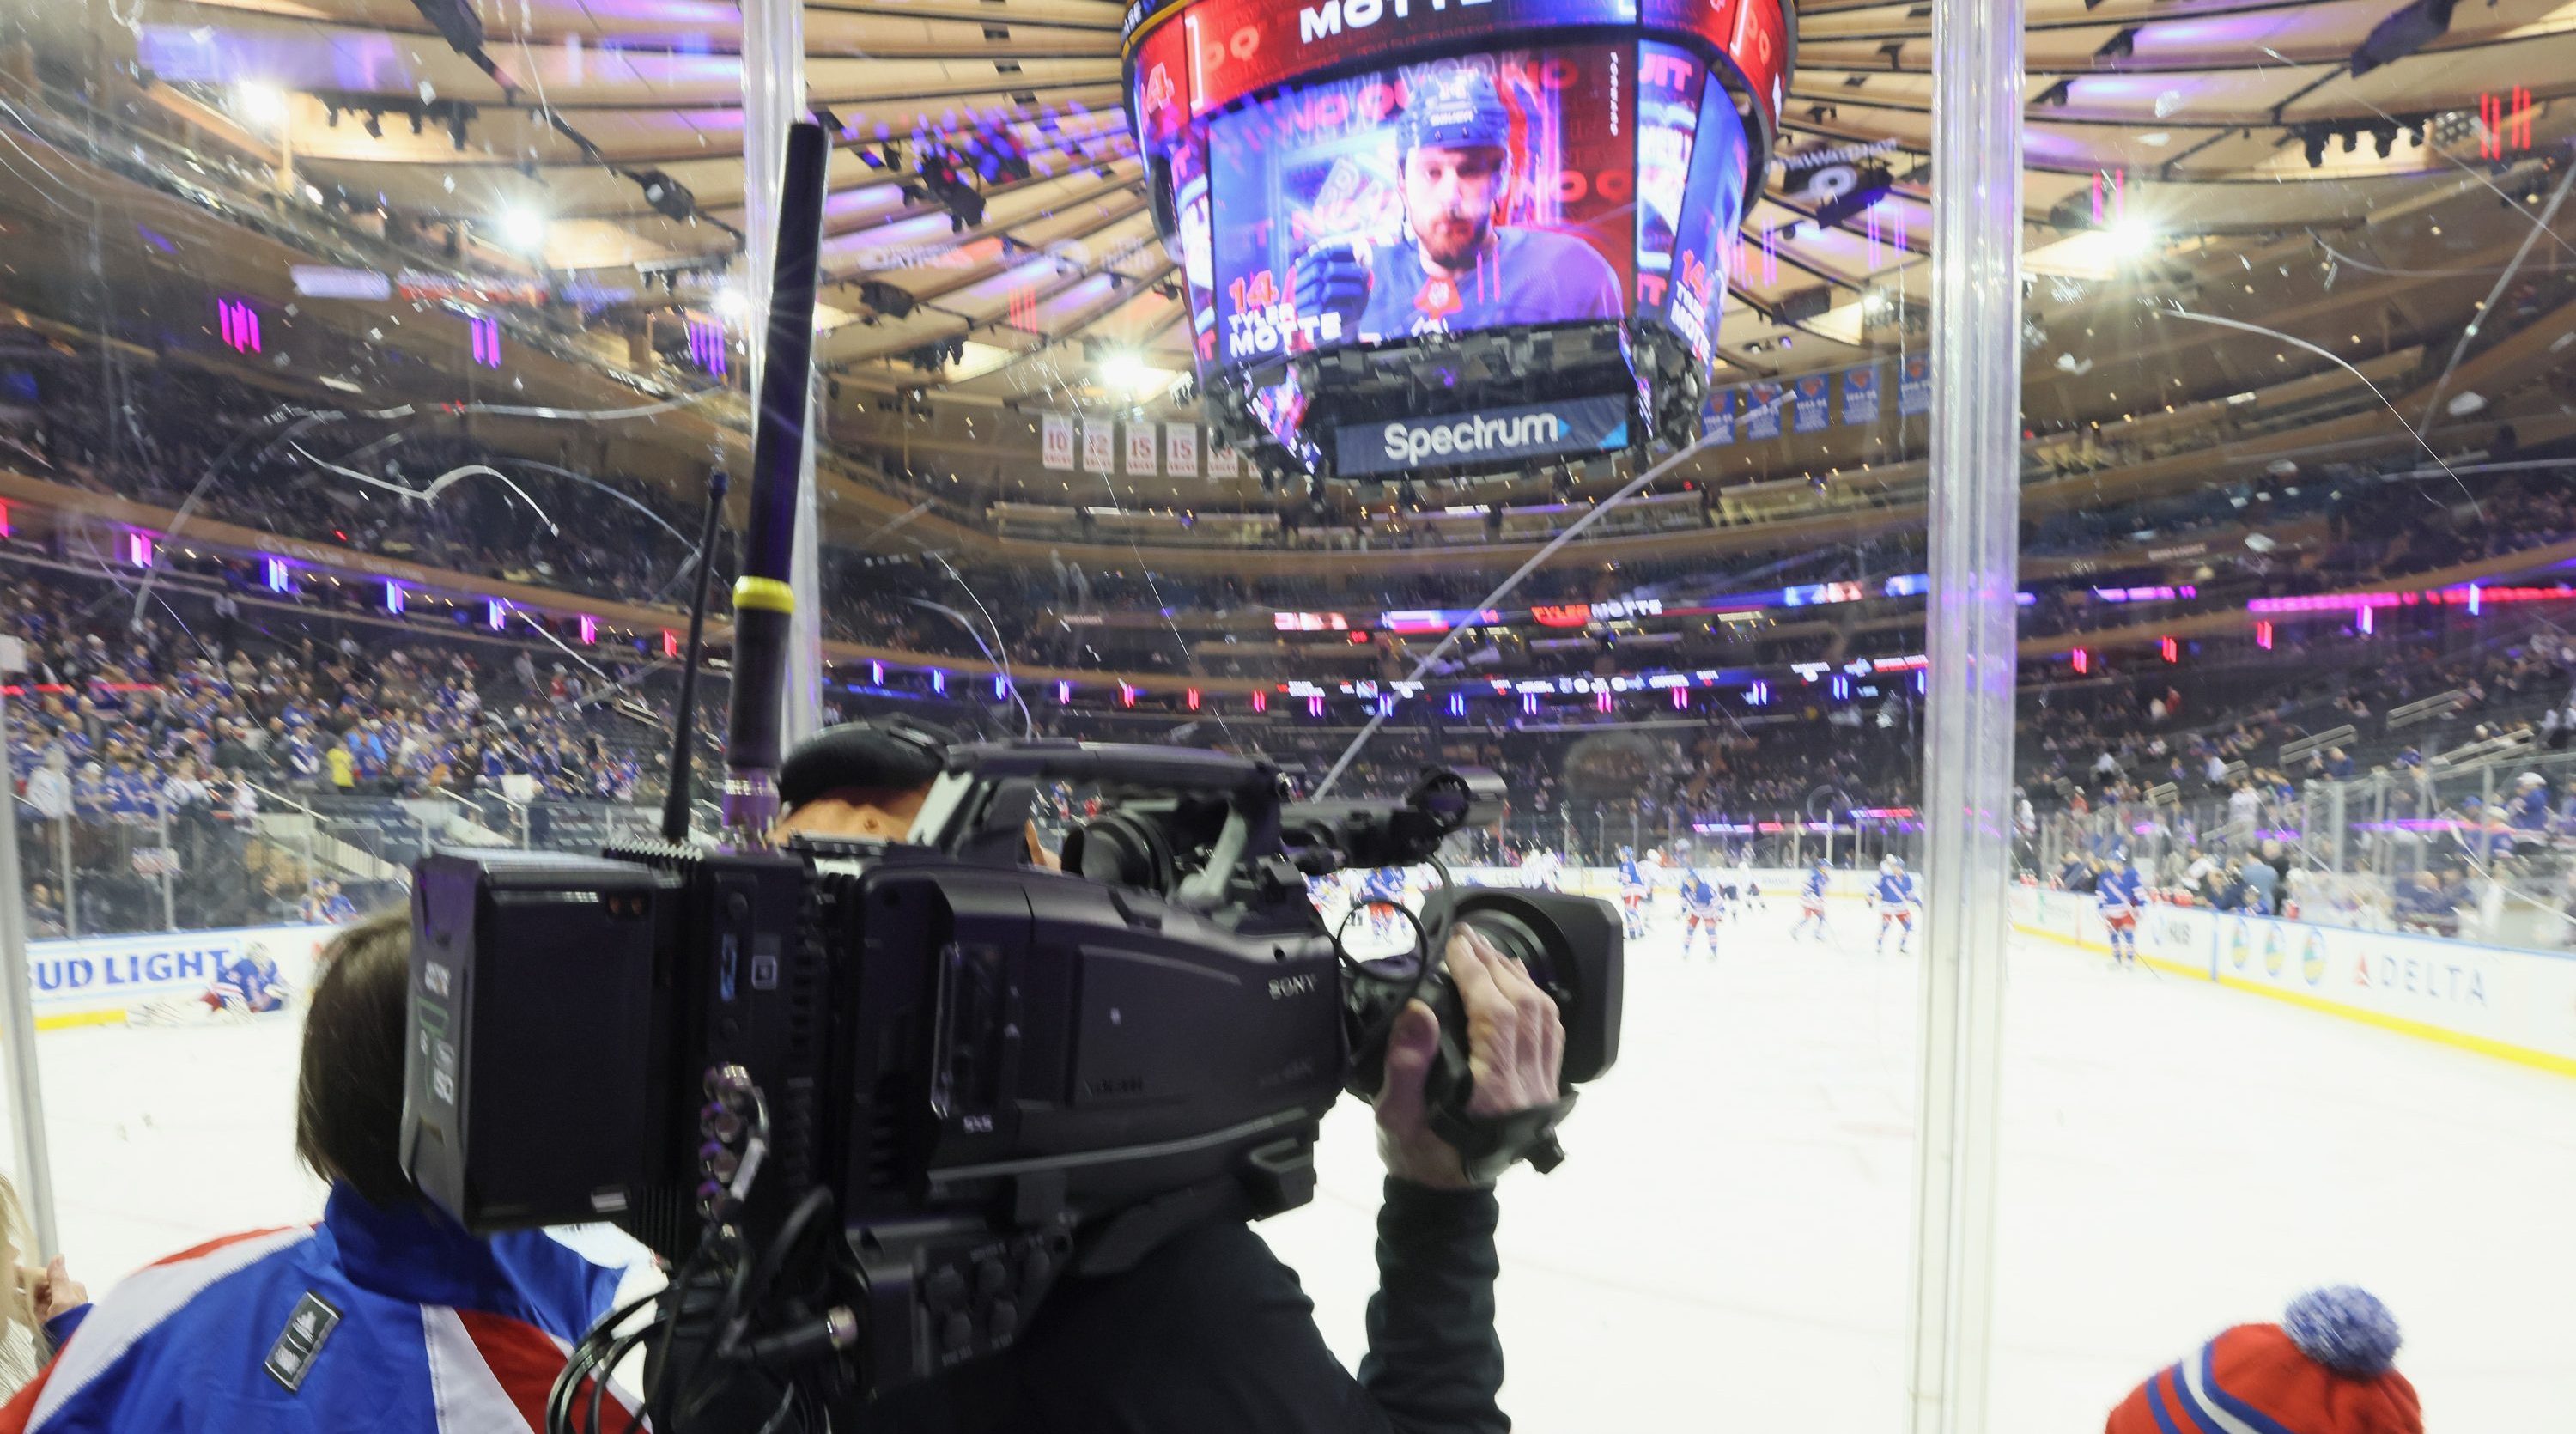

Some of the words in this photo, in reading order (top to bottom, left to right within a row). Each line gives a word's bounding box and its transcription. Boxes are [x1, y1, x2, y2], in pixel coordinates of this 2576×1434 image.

[1229, 270, 1279, 315] 14
[1228, 302, 1299, 334] TYLER
[1229, 311, 1342, 358] MOTTE
[1048, 431, 1068, 451] 10
[1131, 436, 1151, 457] 15
[1172, 439, 1192, 459] 15
[1384, 411, 1560, 466] Spectrum
[1531, 604, 1590, 628] TYLER
[1590, 599, 1663, 622] MOTTE
[33, 958, 94, 992] UD
[104, 947, 232, 985] LIGHT
[2379, 953, 2488, 1007] DELTA
[1268, 974, 1318, 1000] SONY
